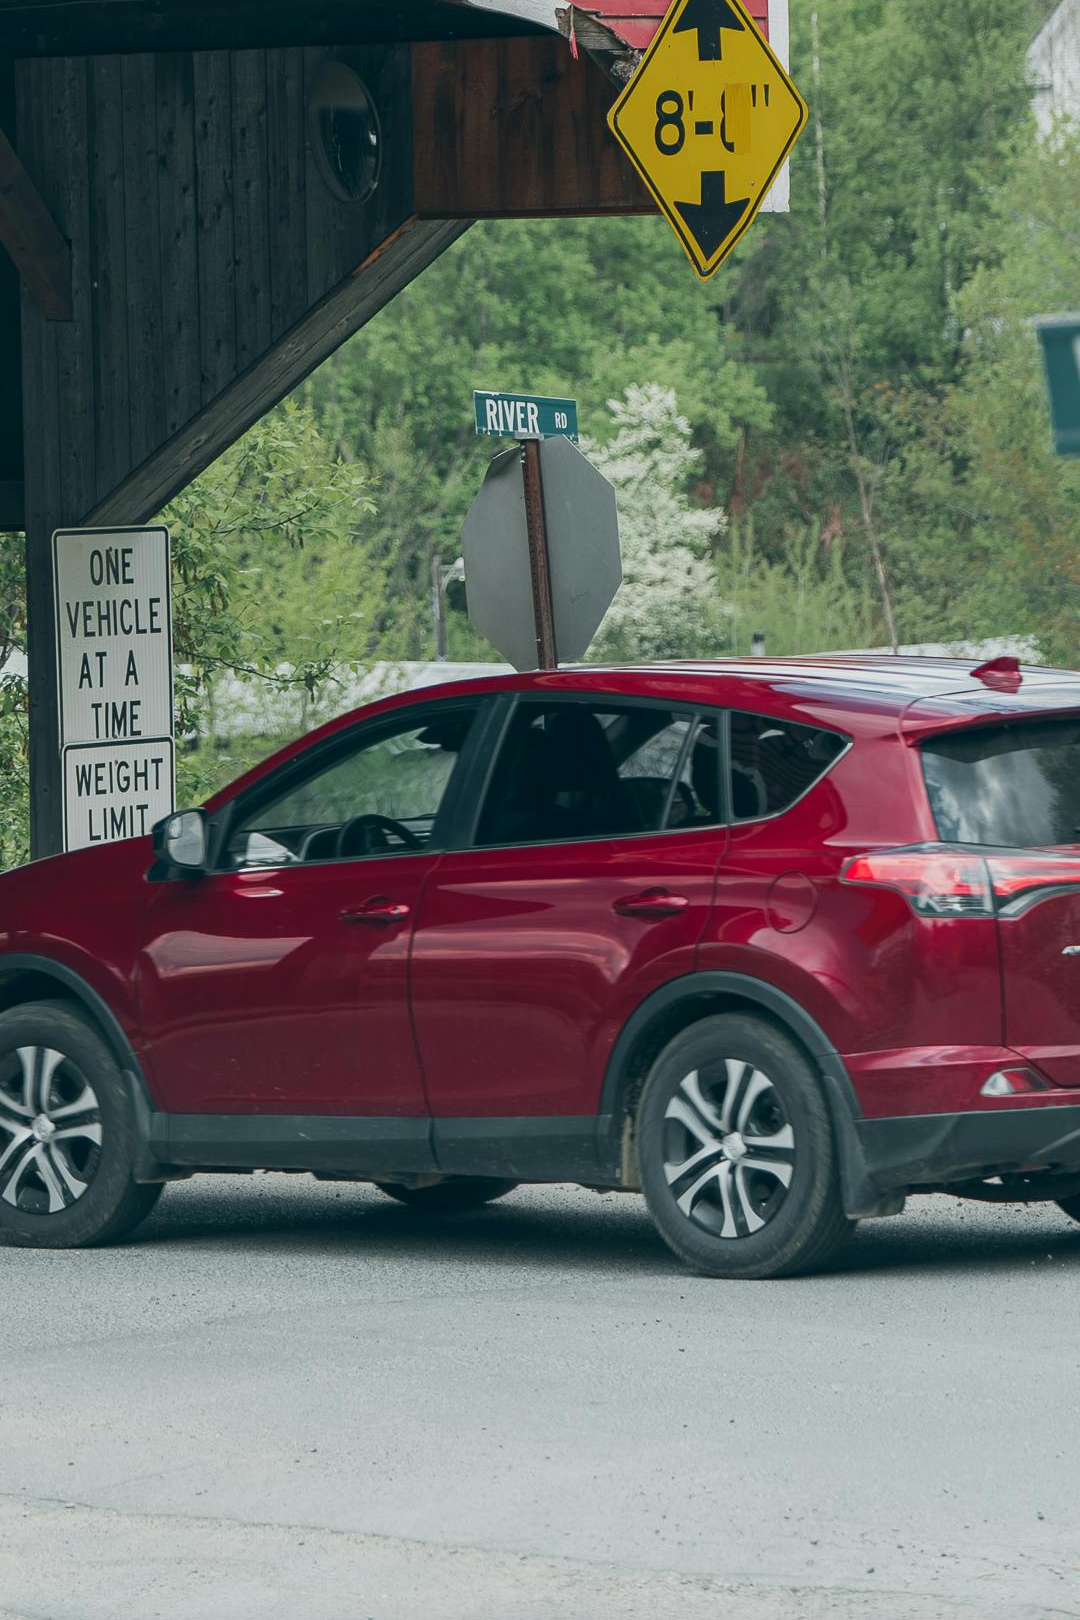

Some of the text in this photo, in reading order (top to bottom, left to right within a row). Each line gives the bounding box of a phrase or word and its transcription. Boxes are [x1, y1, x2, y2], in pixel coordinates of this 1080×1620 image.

[485, 398, 568, 434] RIVER RD
[89, 547, 135, 586] ONE
[66, 597, 162, 638] VEHICLE
[78, 649, 139, 689] AT A
[91, 700, 143, 739] TIME
[75, 757, 164, 797] WEIGHT
[88, 804, 149, 841] LIMIT
